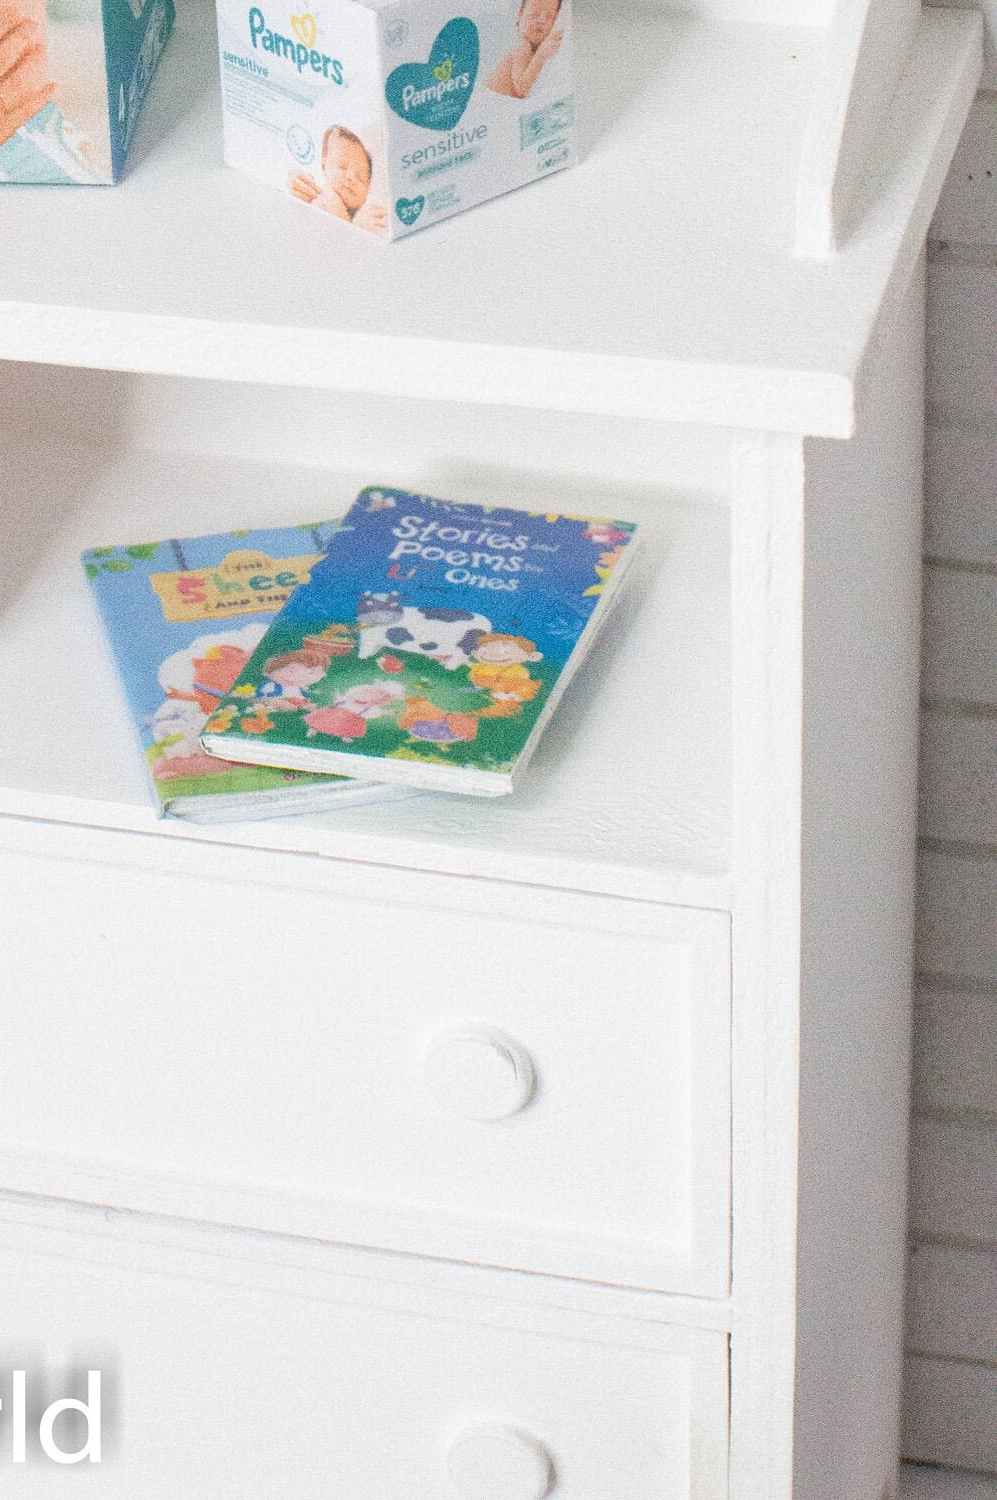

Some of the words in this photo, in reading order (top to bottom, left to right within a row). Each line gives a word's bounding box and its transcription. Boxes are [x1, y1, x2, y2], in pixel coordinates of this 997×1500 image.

[248, 6, 344, 85] Pampers
[222, 50, 269, 78] sensitive
[402, 72, 470, 111] Pampers
[401, 124, 489, 169] sensitive
[392, 515, 530, 551] Stories
[388, 541, 524, 572] Poems
[445, 568, 520, 591] Ones
